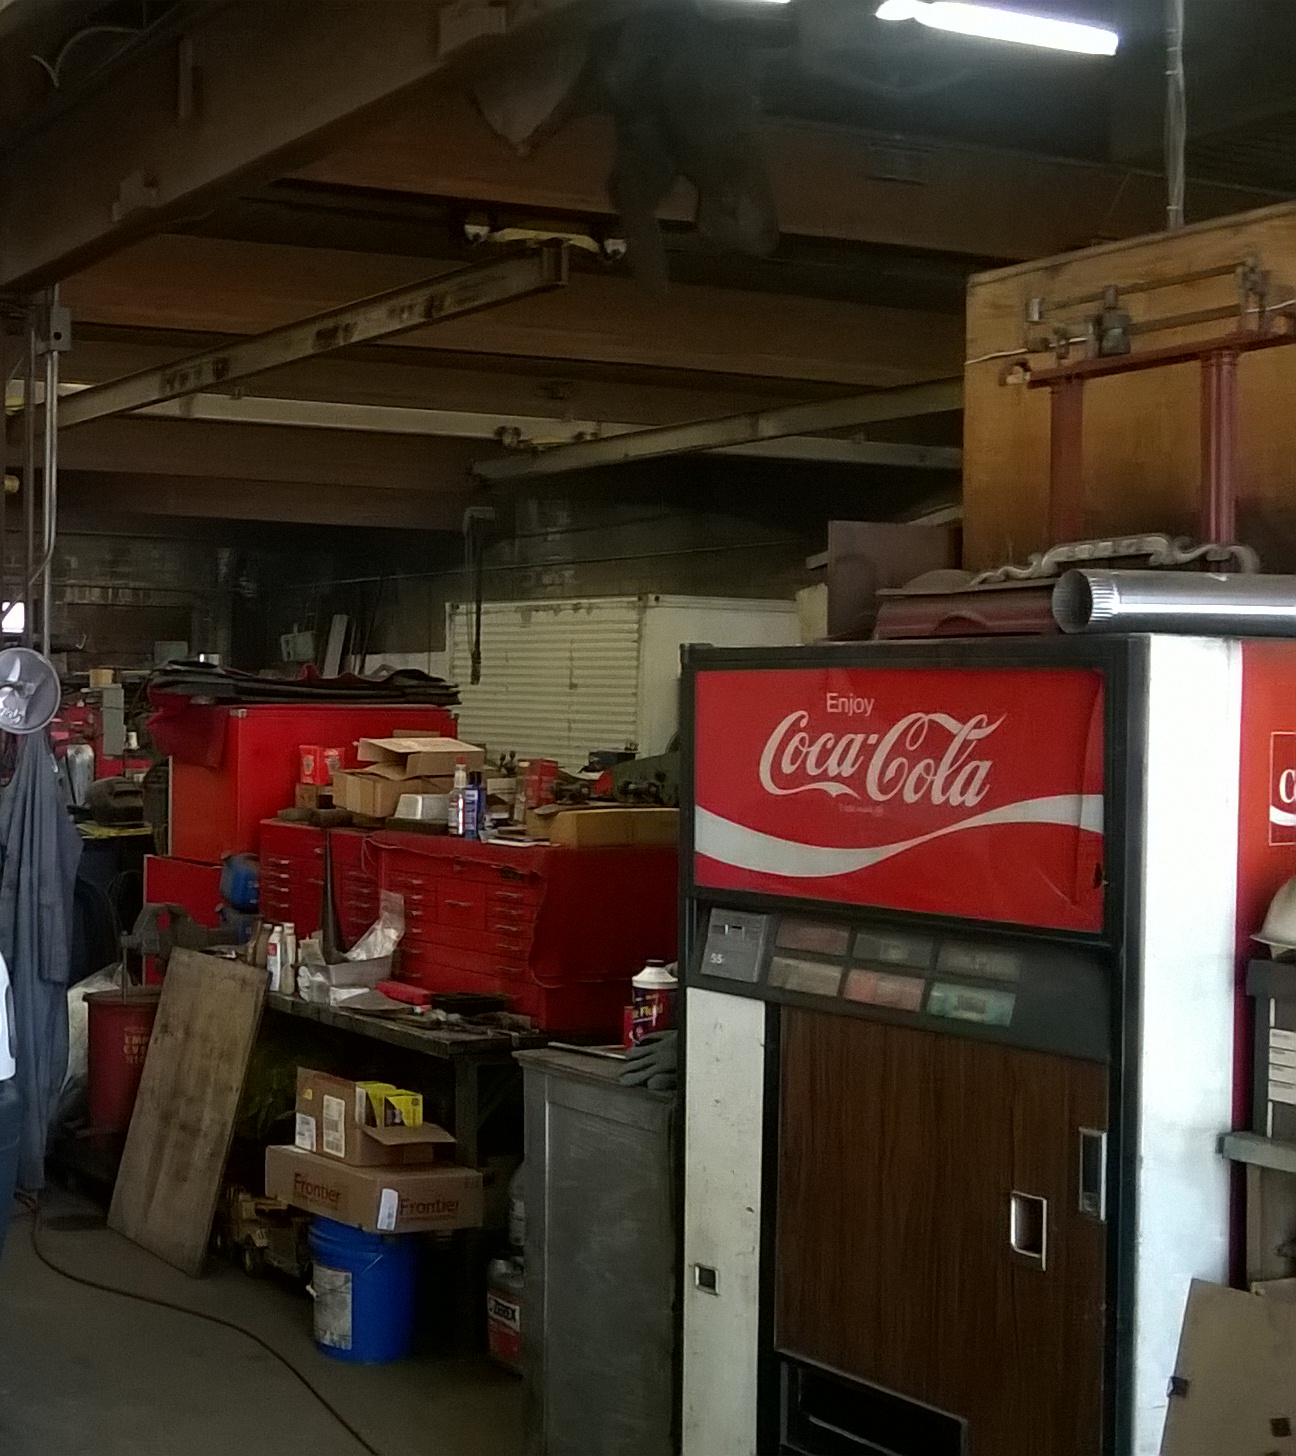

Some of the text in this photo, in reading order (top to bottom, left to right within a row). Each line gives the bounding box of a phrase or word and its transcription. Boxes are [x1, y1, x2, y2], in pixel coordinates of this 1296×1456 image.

[826, 692, 875, 717] Enjoy
[759, 710, 1008, 808] Coca-Cola
[294, 1172, 342, 1204] Frontier
[400, 1197, 460, 1215] Frontier
